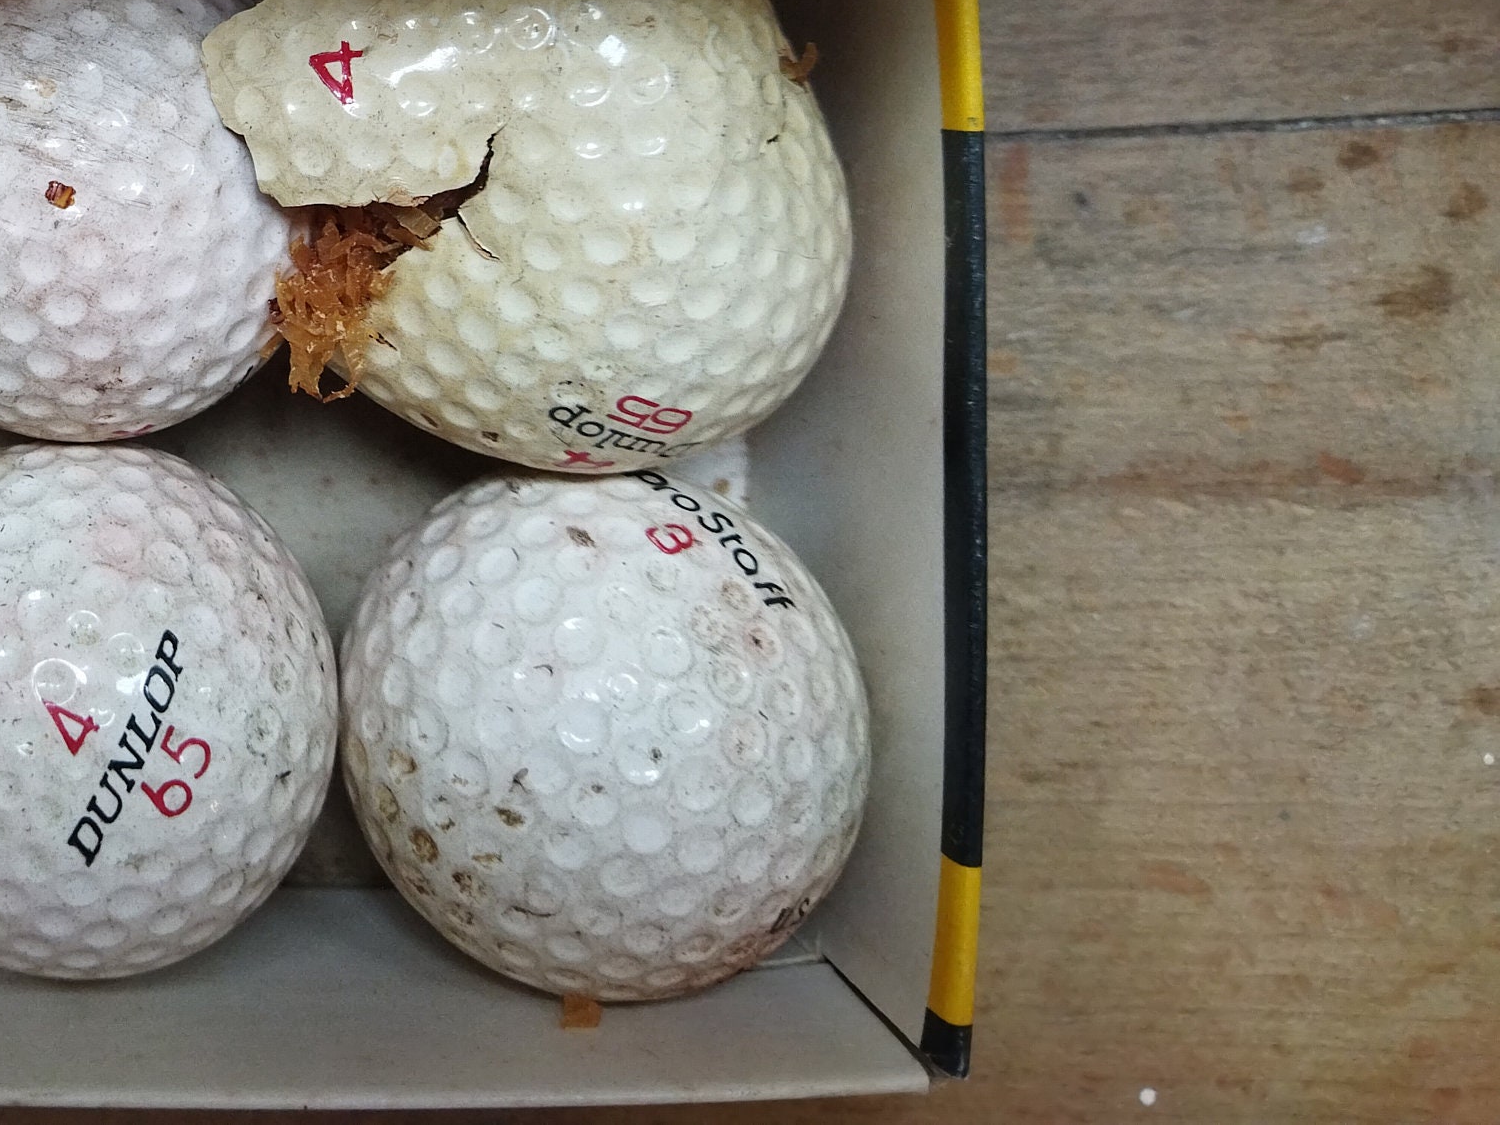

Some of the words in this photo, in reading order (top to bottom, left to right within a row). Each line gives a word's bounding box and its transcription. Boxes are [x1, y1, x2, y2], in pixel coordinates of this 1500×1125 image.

[309, 41, 364, 105] 4
[605, 394, 694, 435] 65
[644, 522, 696, 556] 3
[43, 699, 100, 756] 4
[67, 629, 185, 867] DUNLOP
[141, 725, 212, 818] 65
